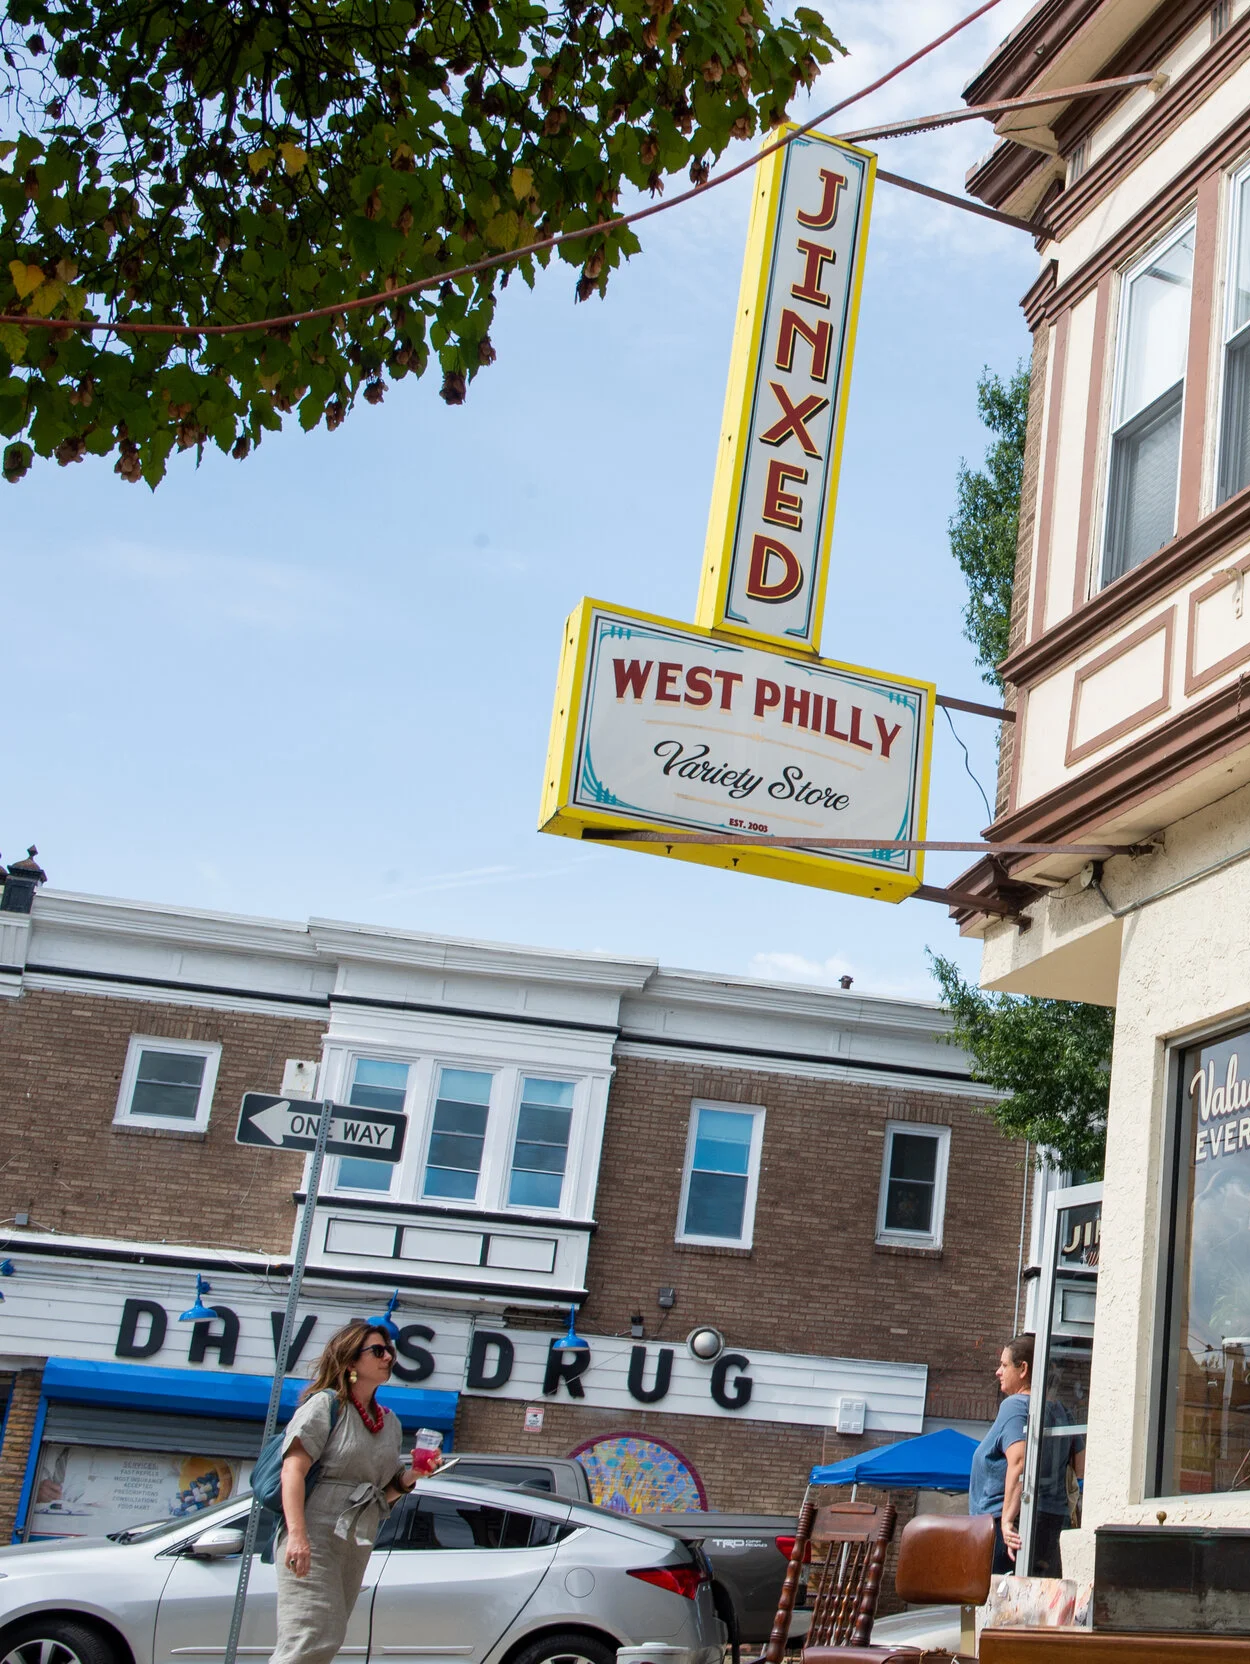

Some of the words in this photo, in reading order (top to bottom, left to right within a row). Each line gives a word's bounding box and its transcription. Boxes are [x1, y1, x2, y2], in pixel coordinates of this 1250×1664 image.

[745, 167, 848, 602] JINXED
[612, 658, 743, 714] WEST
[752, 677, 902, 761] PHILLY
[653, 740, 764, 799] Variety
[767, 765, 850, 811] Store
[729, 817, 746, 829] EST.
[344, 1121, 389, 1145] WAY
[115, 1298, 436, 1382] DAVS
[466, 1330, 753, 1410] DRUG
[712, 1538, 745, 1549] TRD
